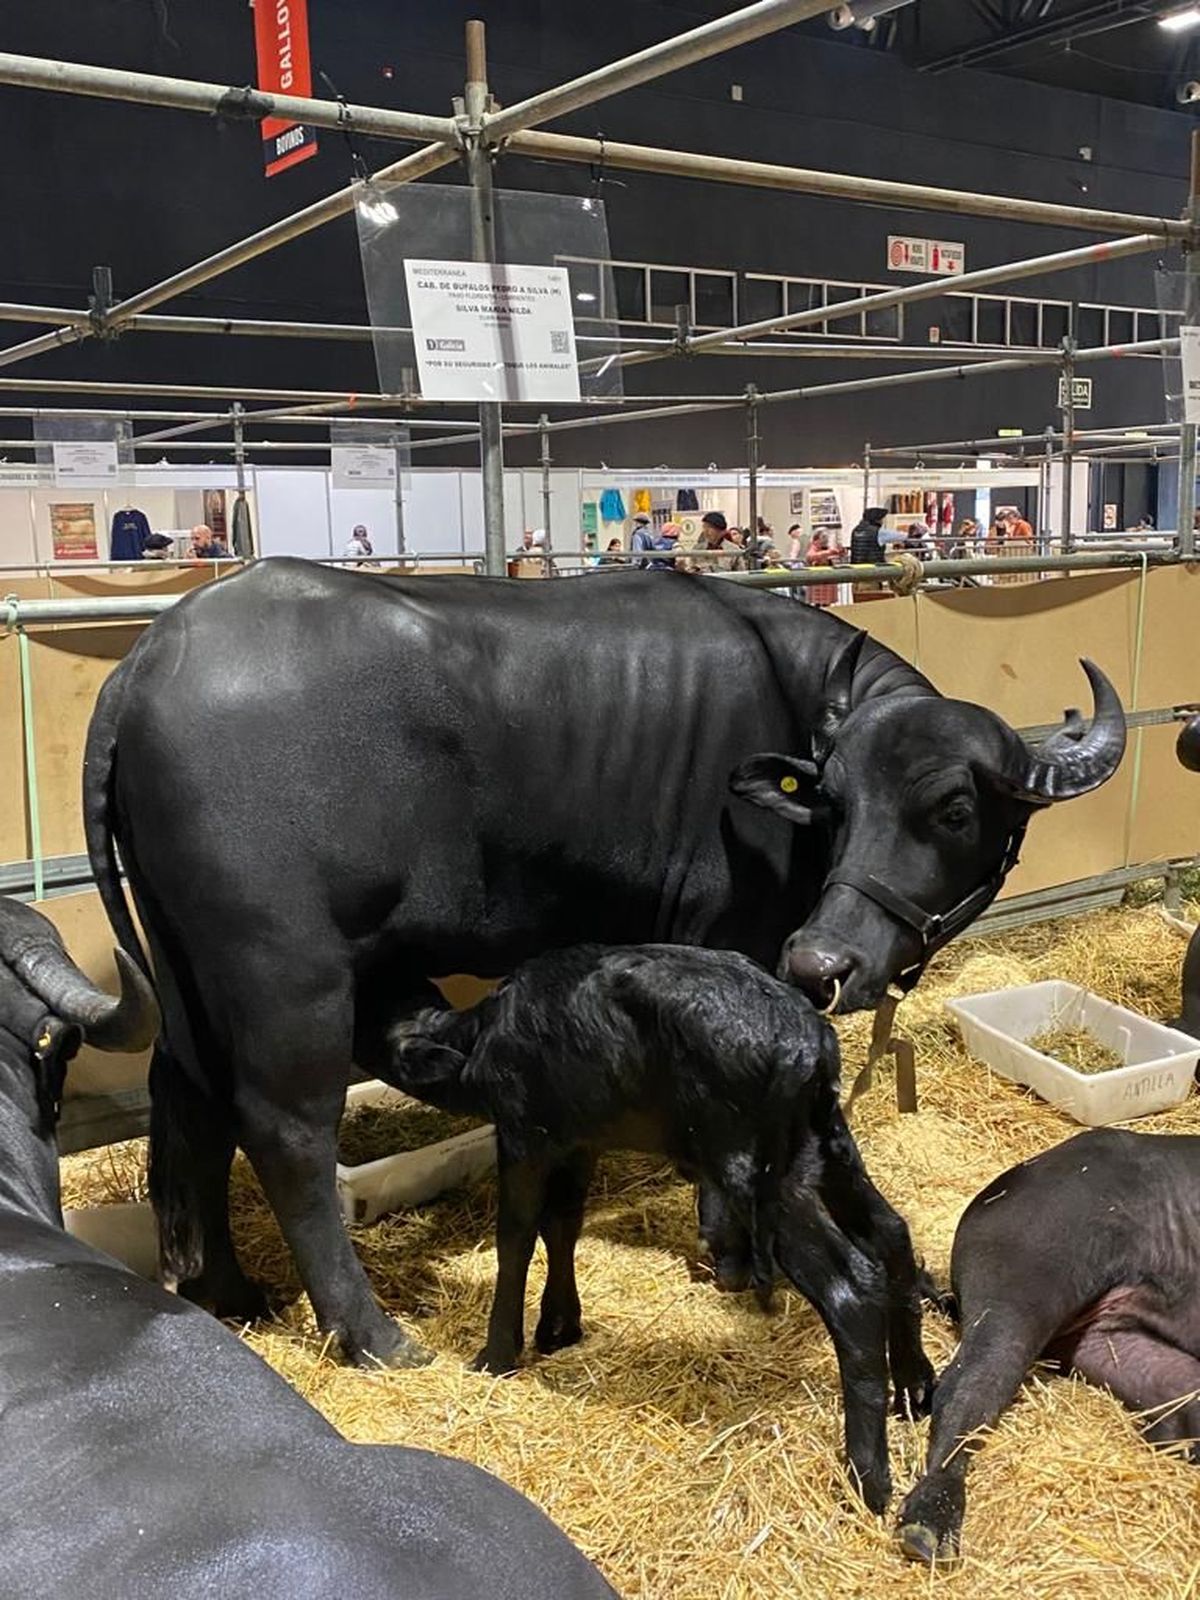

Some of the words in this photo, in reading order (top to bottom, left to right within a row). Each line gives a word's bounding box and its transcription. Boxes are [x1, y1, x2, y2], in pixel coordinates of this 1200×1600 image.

[417, 281, 438, 290] CAB.
[440, 282, 451, 290] DE
[453, 283, 490, 292] BUFALOS
[527, 287, 549, 295] SILVA
[456, 304, 479, 313] SILVA
